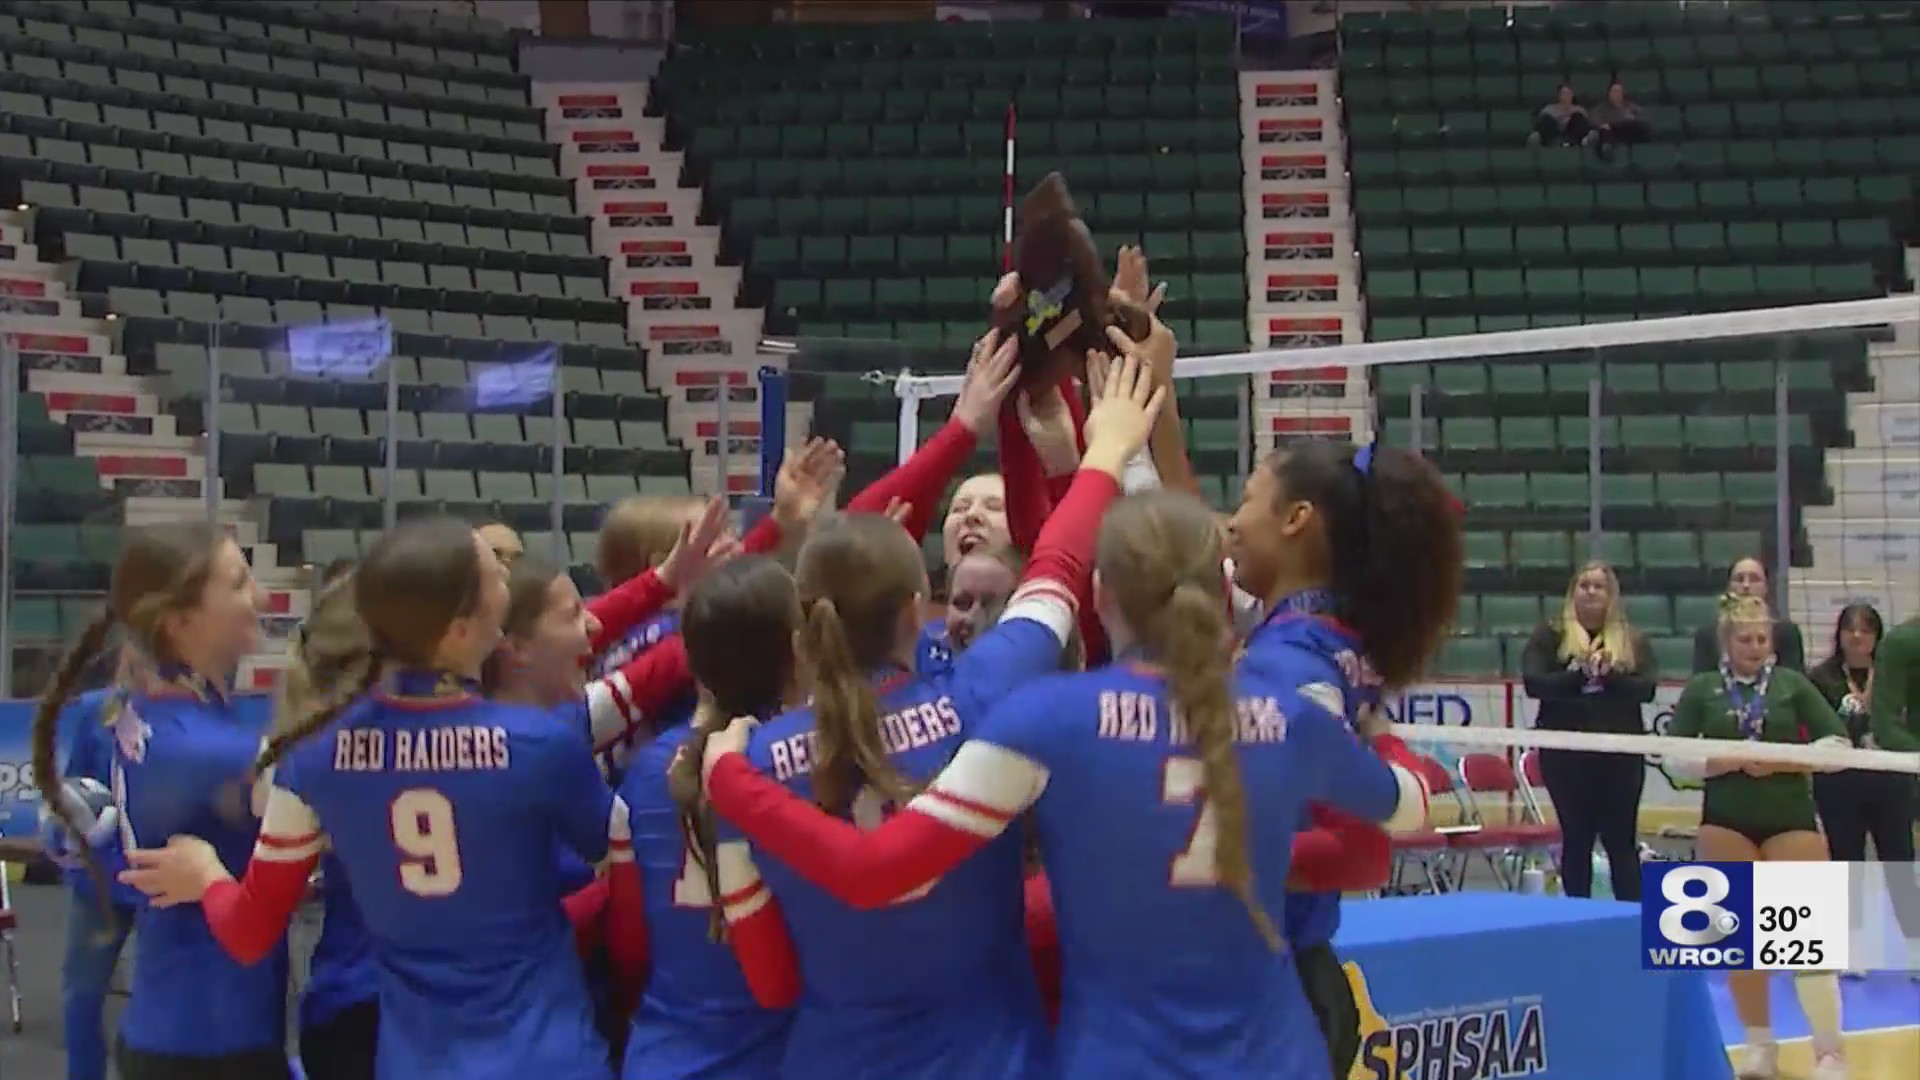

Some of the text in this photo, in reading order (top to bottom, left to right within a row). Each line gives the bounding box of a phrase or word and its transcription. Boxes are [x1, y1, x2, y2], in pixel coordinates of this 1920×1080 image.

[1098, 690, 1157, 742] RED
[334, 725, 511, 772] RED RAIDERS
[388, 786, 464, 899] 9
[1362, 1003, 1547, 1080] SPHSAA
